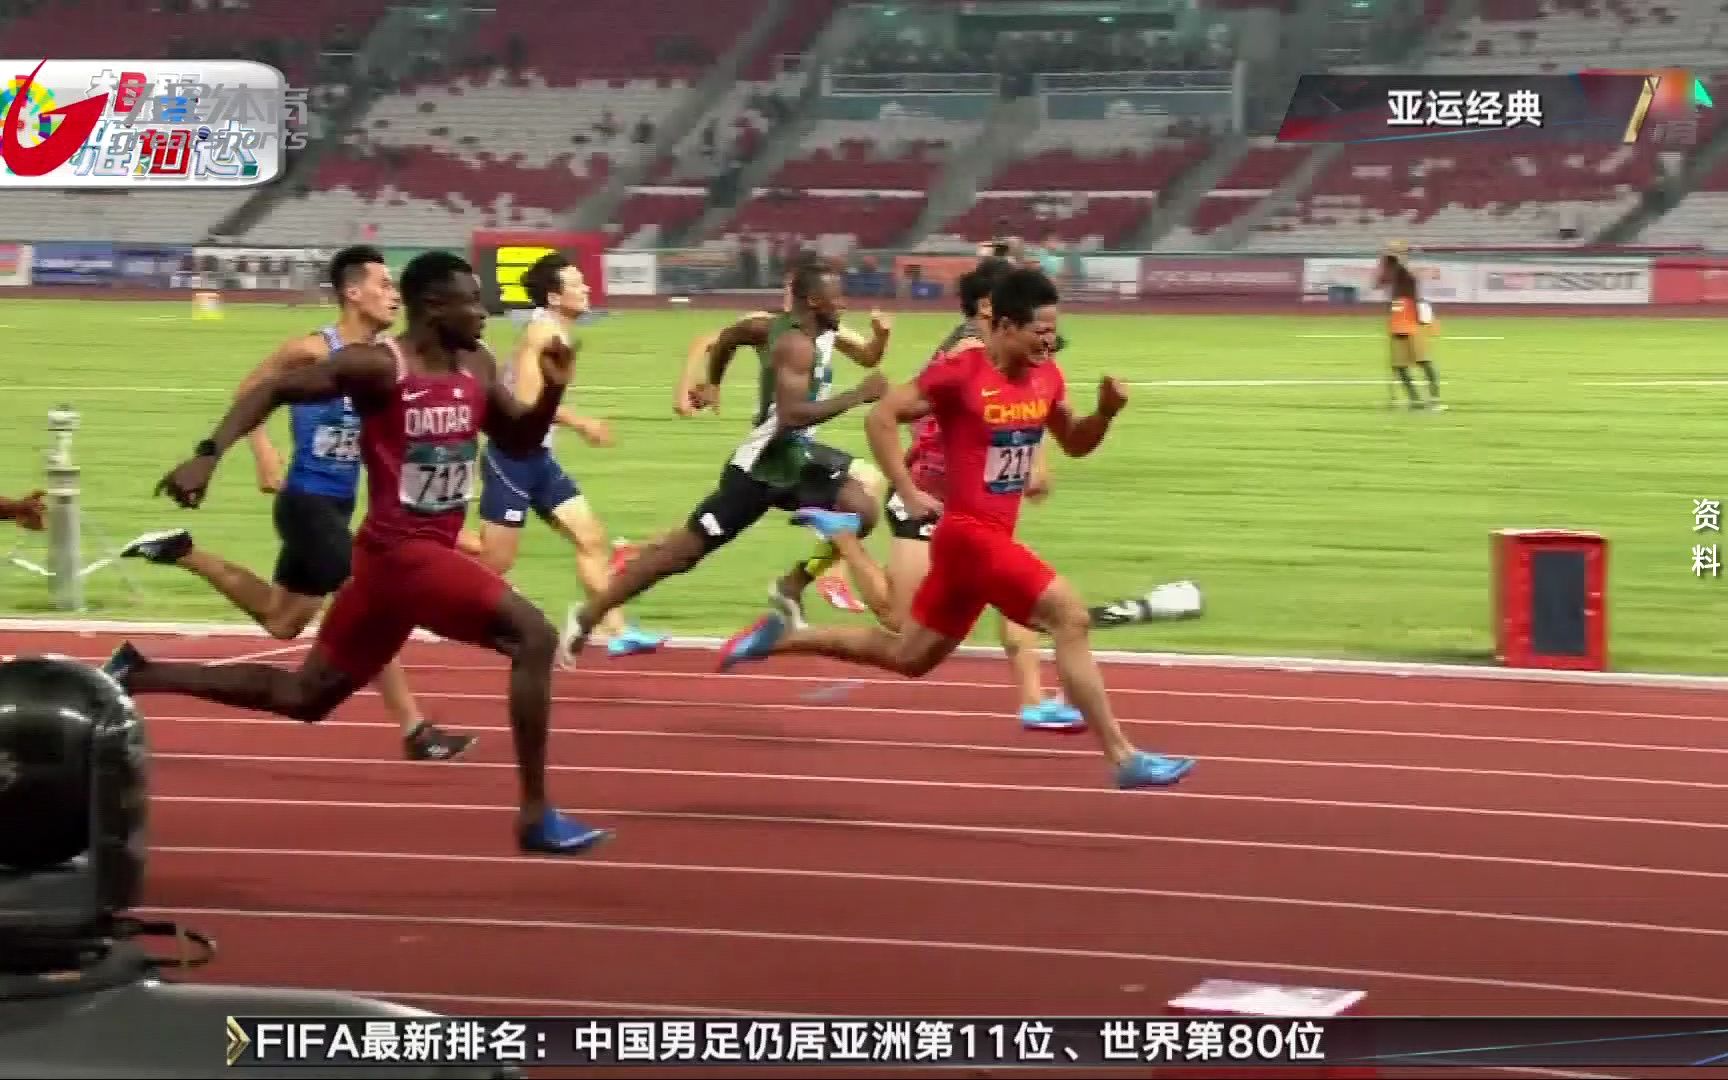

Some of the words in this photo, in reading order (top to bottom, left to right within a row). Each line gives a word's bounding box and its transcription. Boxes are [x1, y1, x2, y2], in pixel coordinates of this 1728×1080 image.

[405, 405, 471, 436] QATAR
[984, 399, 1049, 424] CHINA
[417, 464, 466, 503] 712
